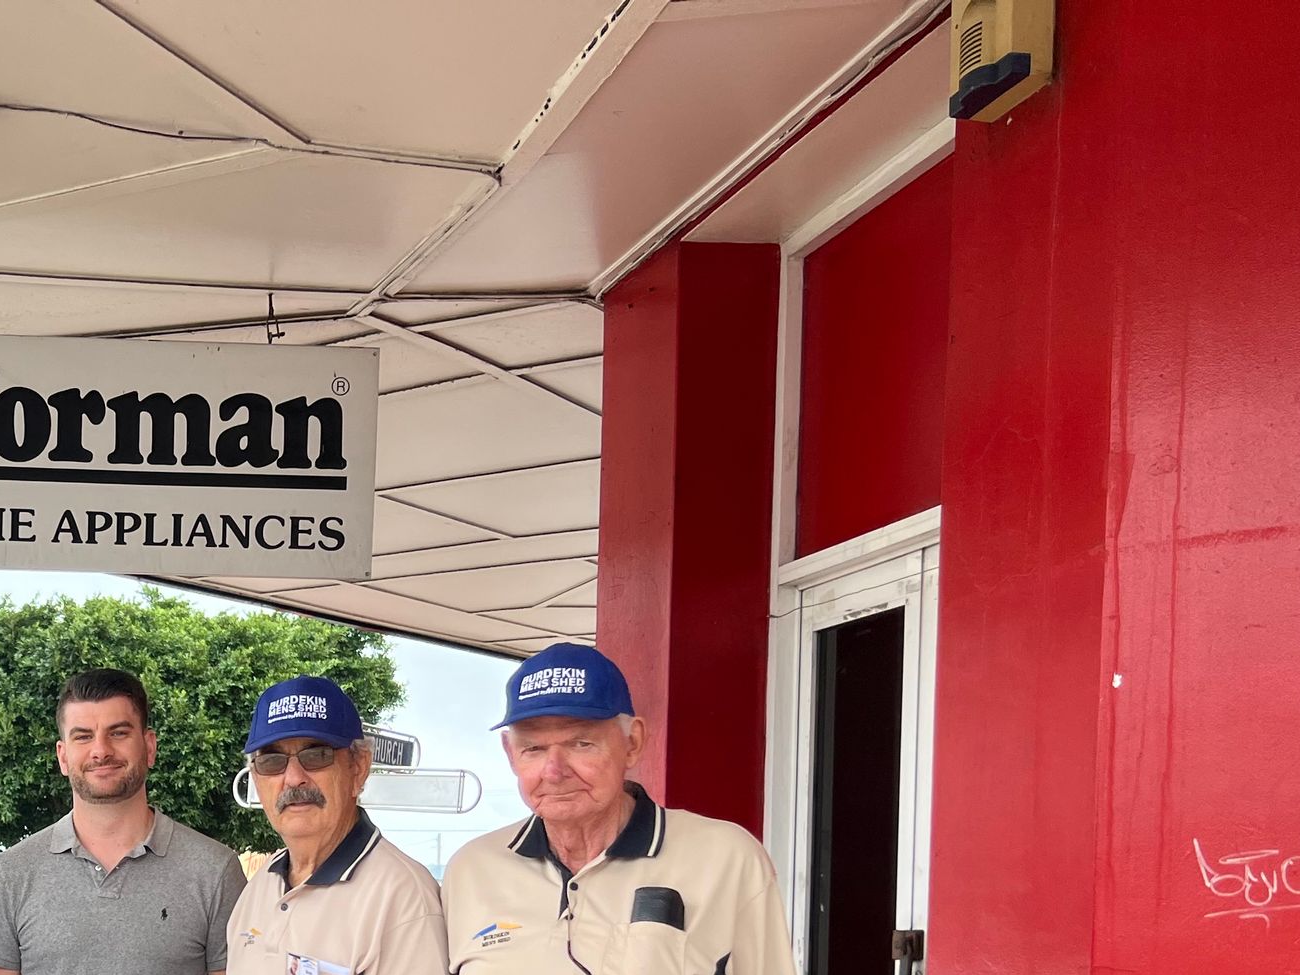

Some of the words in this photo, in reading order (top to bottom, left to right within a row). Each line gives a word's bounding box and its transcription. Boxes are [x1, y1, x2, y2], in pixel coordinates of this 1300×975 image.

[50, 508, 346, 552] APPLIANCES
[521, 667, 586, 685] BURDEKIN
[519, 678, 550, 694] MENS
[551, 677, 586, 687] SHED
[546, 686, 573, 694] MITRE
[269, 694, 327, 710] BURDEKIN
[268, 704, 296, 718] MENS
[297, 703, 327, 713] SHED
[293, 711, 317, 719] MITRE
[374, 737, 404, 766] HURCH
